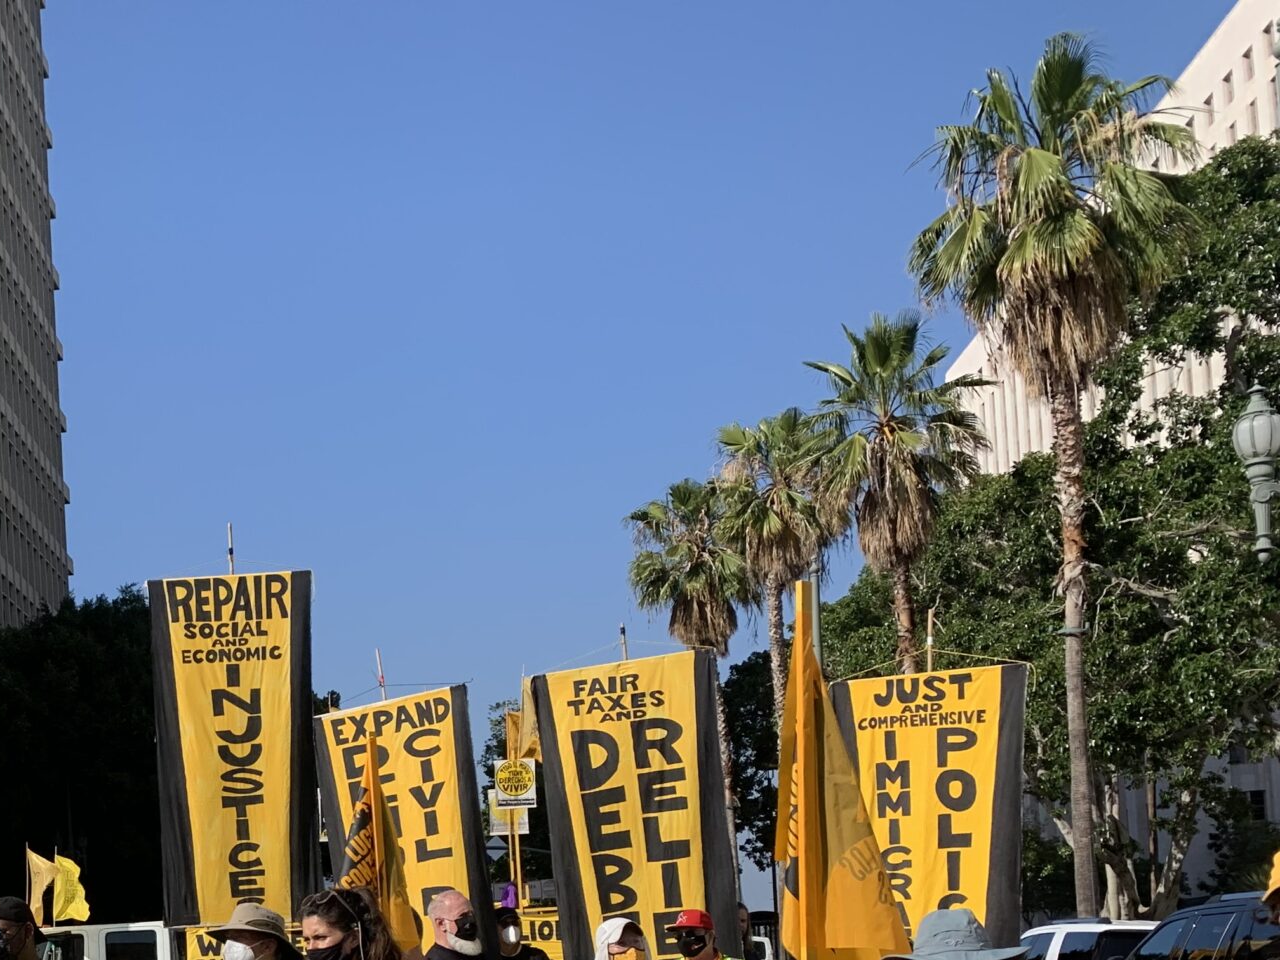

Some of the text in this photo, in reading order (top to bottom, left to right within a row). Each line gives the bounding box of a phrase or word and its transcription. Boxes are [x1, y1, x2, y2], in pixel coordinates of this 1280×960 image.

[164, 573, 290, 623] REPAIR
[183, 620, 269, 640] SOCIAL
[211, 637, 250, 648] AND
[181, 645, 283, 664] ECONOMIC
[572, 673, 640, 698] FAIR
[873, 672, 973, 708] JUST
[567, 689, 665, 717] TAXES
[900, 702, 943, 715] AND
[330, 696, 451, 747] EXPAND
[599, 709, 647, 724] AND
[857, 709, 987, 731] COMPREHENSIVE
[210, 663, 265, 907] INJUSTICE
[403, 728, 454, 863] CIVIL
[502, 783, 529, 792] VIVIR
[934, 727, 978, 911] POLI
[630, 717, 691, 958] RELIE
